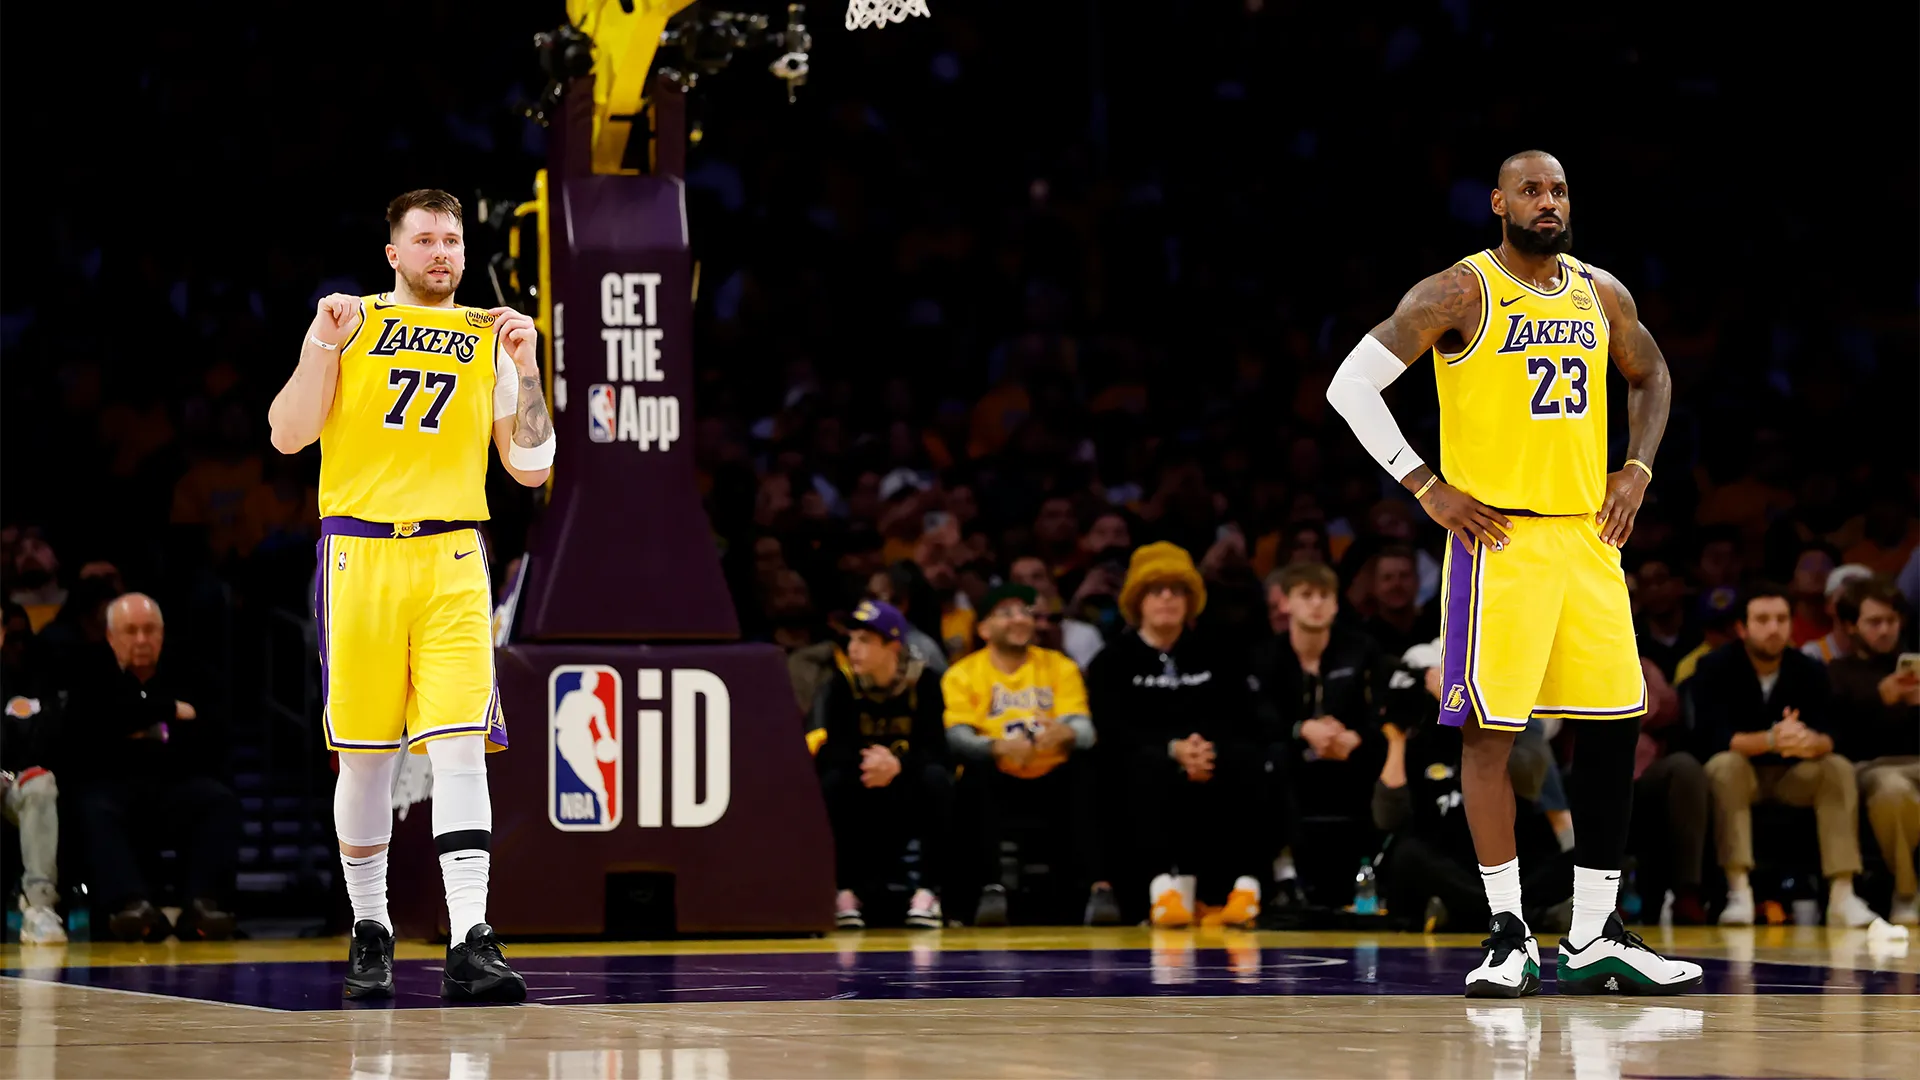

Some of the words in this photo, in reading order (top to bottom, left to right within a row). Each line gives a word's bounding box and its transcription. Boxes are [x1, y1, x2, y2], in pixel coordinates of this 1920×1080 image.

[468, 311, 494, 324] bibigo
[601, 272, 662, 326] GET
[368, 318, 480, 364] LAKERS
[601, 328, 664, 382] THE
[1497, 313, 1597, 354] LAKERS
[383, 368, 457, 434] 77
[1527, 357, 1588, 420] 23
[617, 385, 680, 452] App
[637, 668, 731, 828] iD
[560, 792, 595, 820] NBA
